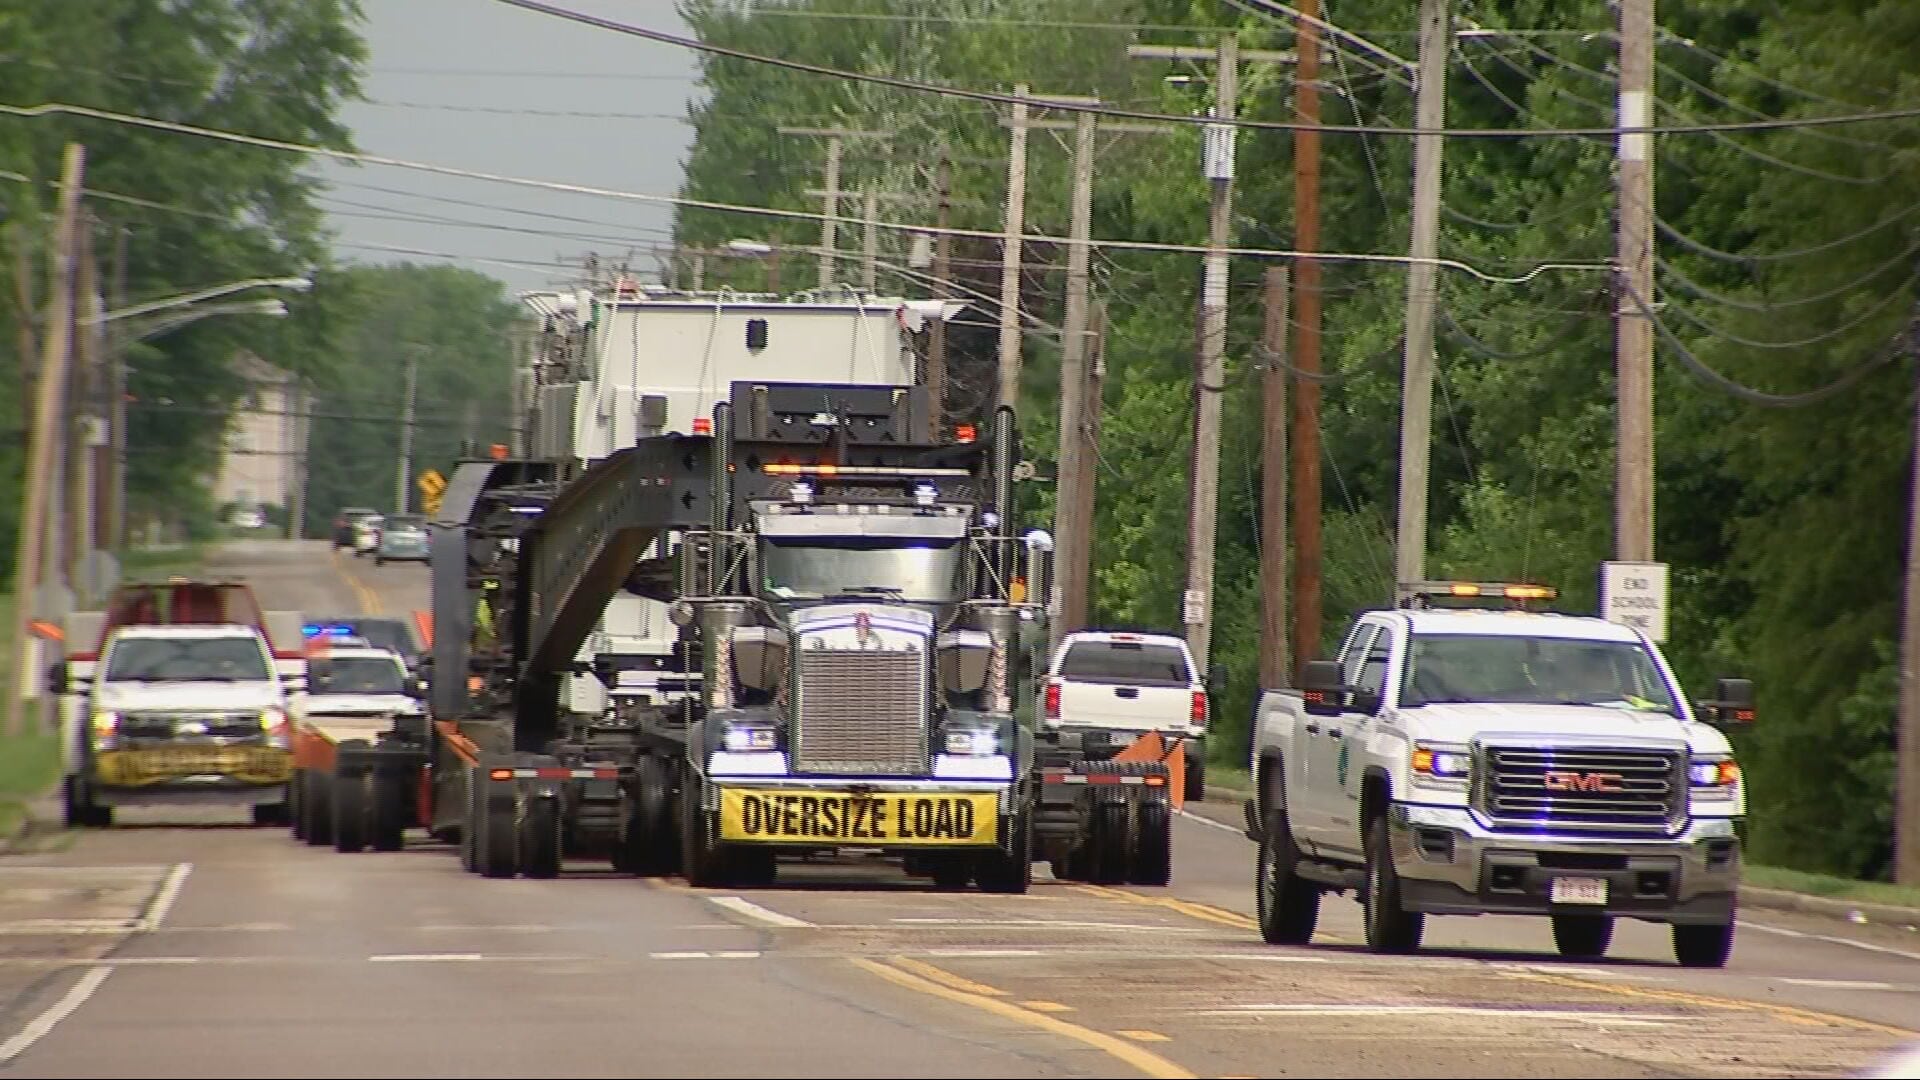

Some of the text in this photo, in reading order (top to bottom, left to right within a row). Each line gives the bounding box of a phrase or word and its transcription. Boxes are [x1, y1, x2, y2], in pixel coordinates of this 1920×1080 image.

[1622, 577, 1648, 590] END
[1611, 596, 1660, 610] SCHOOL
[1544, 771, 1623, 793] GMC
[742, 795, 975, 840] OVERSIZE LOAD
